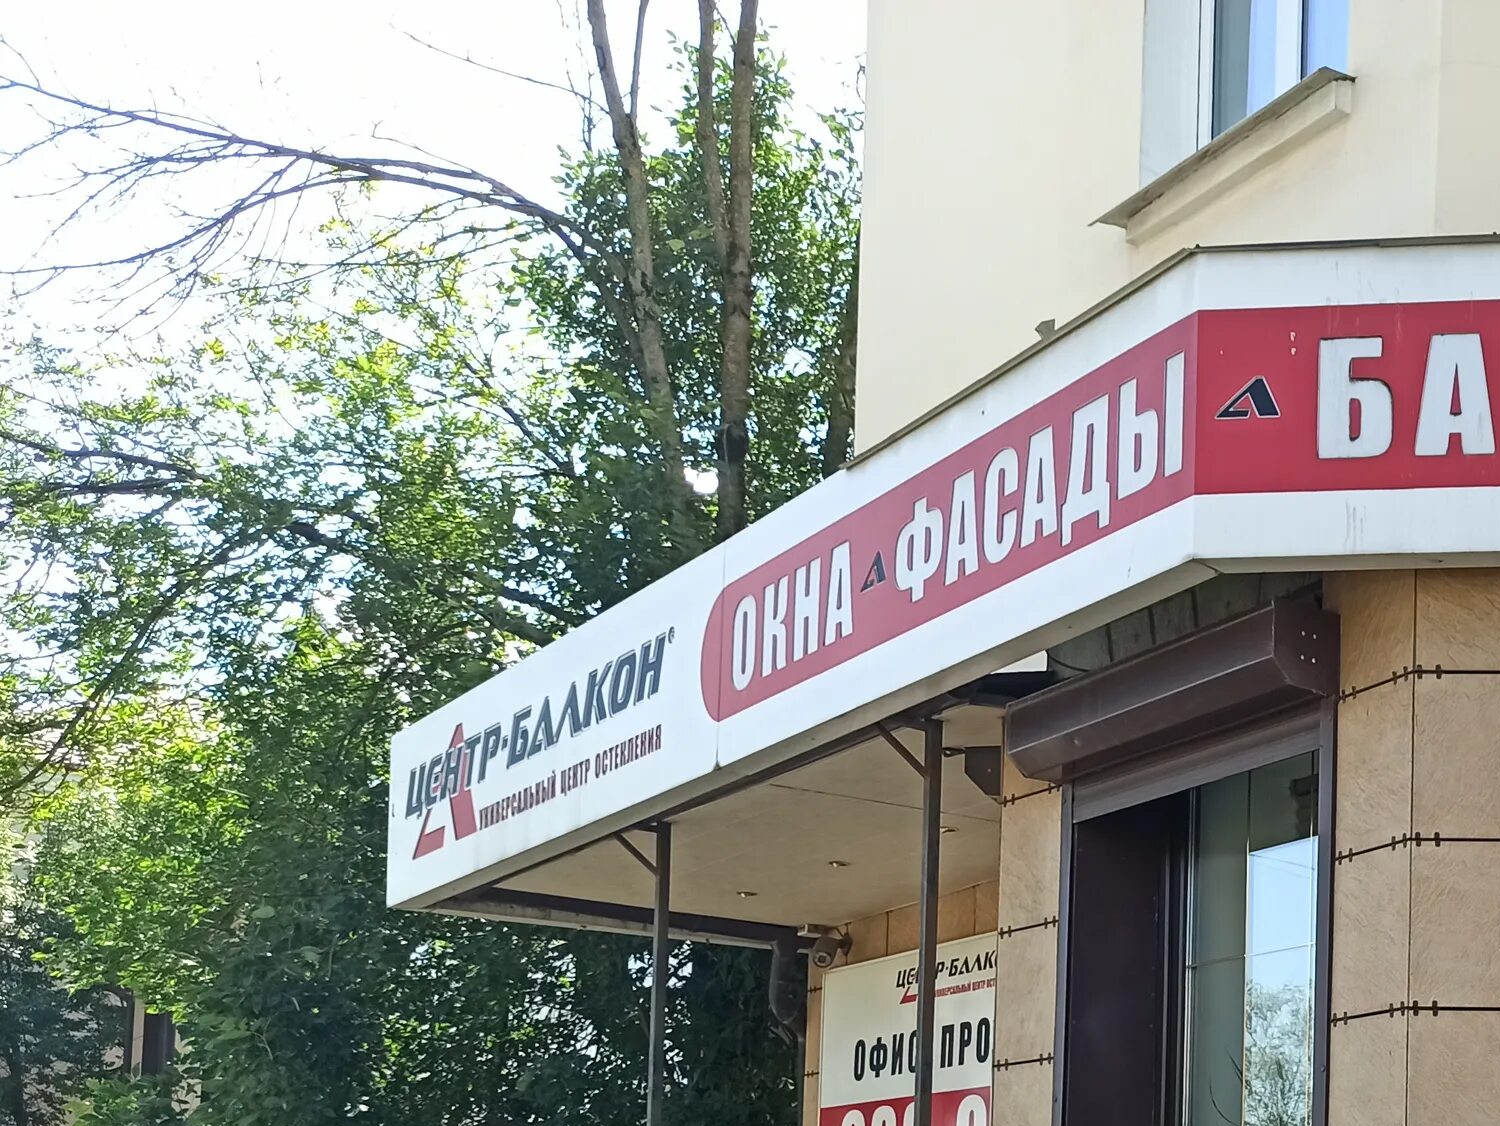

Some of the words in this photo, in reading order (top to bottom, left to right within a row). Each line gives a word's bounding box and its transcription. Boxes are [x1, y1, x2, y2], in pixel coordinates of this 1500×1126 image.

[731, 540, 854, 691] ОКНА
[895, 351, 1185, 603] ФАСАДЫ
[560, 758, 591, 796] ЦЕНТР
[594, 724, 663, 779] ОСТЕКЛЕНИЯ
